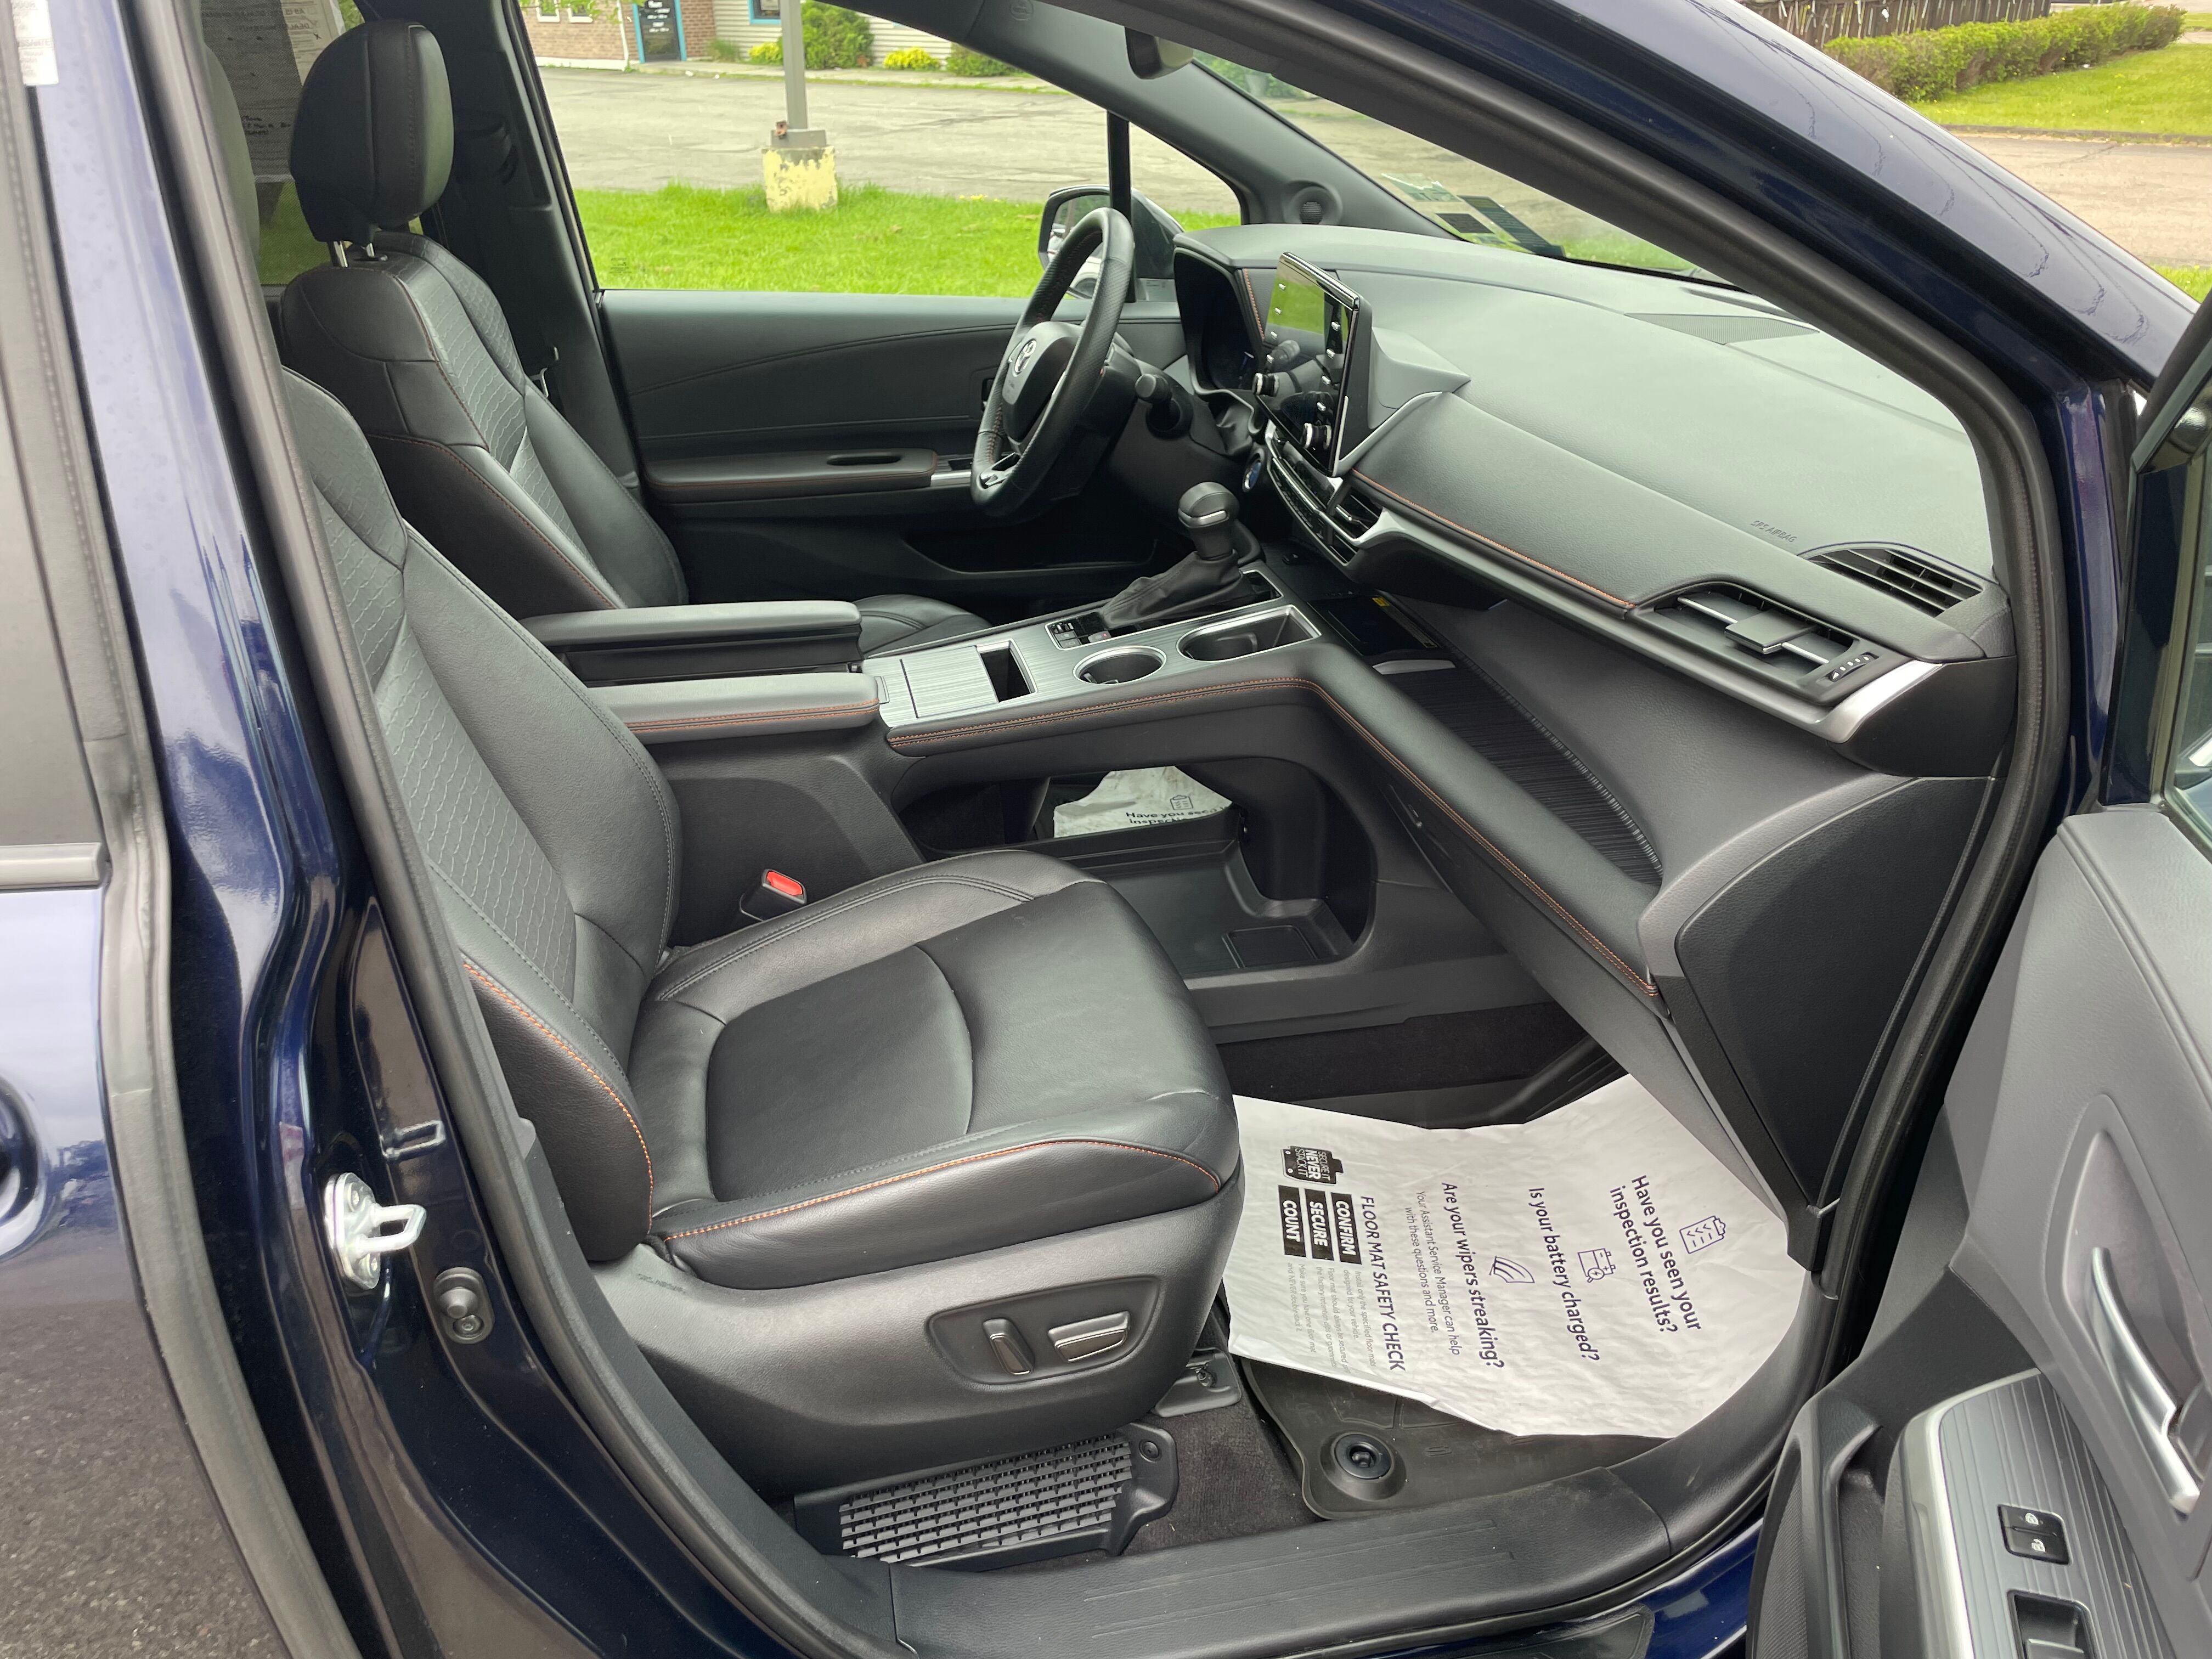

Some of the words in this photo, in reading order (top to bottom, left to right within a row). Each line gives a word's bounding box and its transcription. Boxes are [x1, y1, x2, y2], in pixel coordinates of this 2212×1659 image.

[1294, 1148, 1307, 1169] STACK
[1305, 1149, 1322, 1180] NEVER
[1318, 1150, 1330, 1173] SECURE
[1297, 1168, 1308, 1178] IT
[1321, 1173, 1331, 1181] IT
[1417, 1191, 1426, 1209] Your
[1441, 1182, 1458, 1203] Are
[1528, 1188, 1545, 1198] Is
[1631, 1175, 1655, 1216] Have
[1283, 1200, 1301, 1243] COUNT
[1309, 1201, 1328, 1247] SECURE
[1361, 1195, 1380, 1239] FLOOR
[1405, 1206, 1417, 1223] with
[1443, 1206, 1466, 1236] your
[1528, 1201, 1554, 1232] your
[1335, 1200, 1357, 1256] CONFIRM
[1409, 1224, 1420, 1248] these
[1419, 1210, 1435, 1245] Assistant
[1643, 1217, 1668, 1248] you
[1287, 1262, 1295, 1274] and
[1368, 1242, 1386, 1270] MAT
[1414, 1248, 1429, 1288] questions
[1429, 1245, 1442, 1274] Service
[1455, 1239, 1479, 1286] wipers
[1543, 1234, 1571, 1289] battery
[1610, 1185, 1649, 1268] inspection
[1640, 1270, 1678, 1332] results?
[1298, 1263, 1306, 1279] Make
[1355, 1271, 1364, 1288] Install
[1660, 1250, 1684, 1290] seen
[1289, 1275, 1297, 1295] NEVER
[1317, 1276, 1325, 1295] factory
[1344, 1269, 1353, 1296] designed
[1290, 1294, 1299, 1313] double
[1300, 1291, 1308, 1304] you
[1331, 1294, 1340, 1314] should
[1357, 1289, 1366, 1301] only
[1373, 1271, 1396, 1321] SAFETY
[1423, 1290, 1436, 1306] and
[1435, 1277, 1452, 1315] Manager
[1320, 1294, 1328, 1321] retention
[1347, 1304, 1356, 1318] your
[1670, 1290, 1701, 1329] your
[1334, 1314, 1342, 1332] always
[1361, 1311, 1372, 1338] specified
[1426, 1308, 1439, 1333] more.
[1444, 1315, 1455, 1332] can
[1468, 1289, 1505, 1368] streaking?
[1561, 1291, 1600, 1361] charged?
[1307, 1328, 1315, 1341] floor
[1325, 1333, 1333, 1341] or
[1365, 1337, 1374, 1353] floor
[1448, 1334, 1463, 1355] help
[1339, 1340, 1349, 1364] secured
[1382, 1322, 1406, 1372] CHECK
[1368, 1353, 1376, 1367] mats
